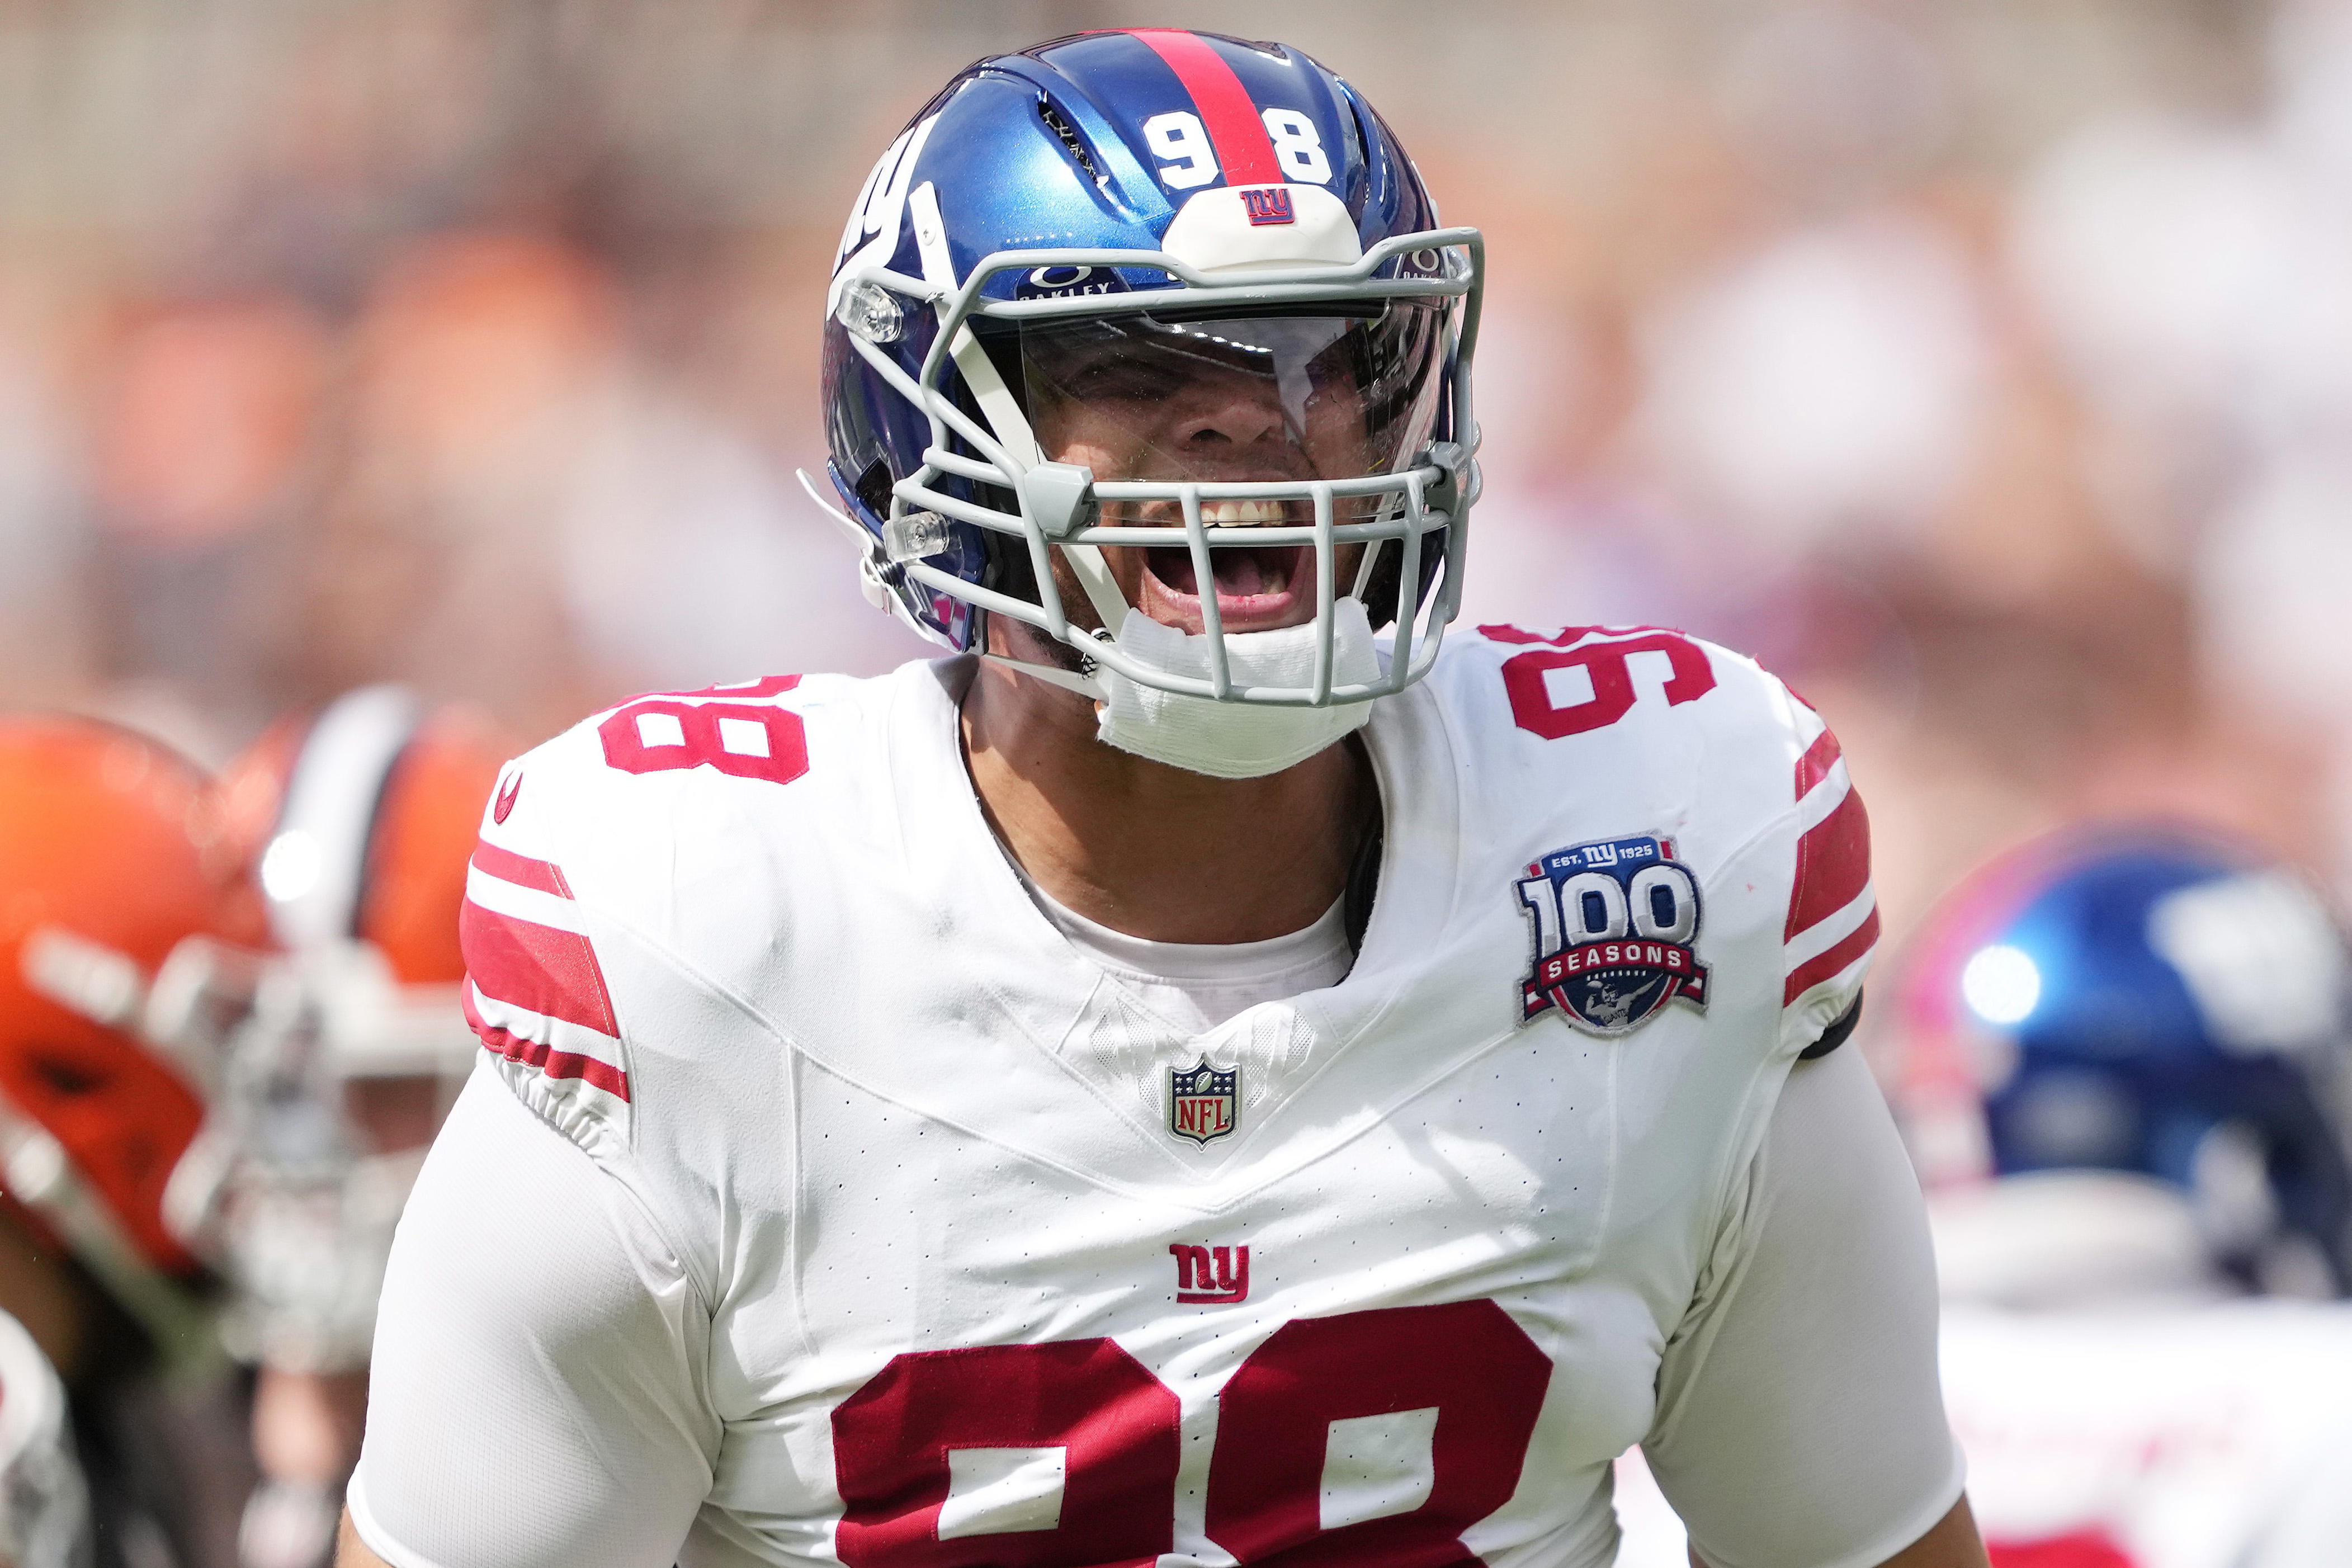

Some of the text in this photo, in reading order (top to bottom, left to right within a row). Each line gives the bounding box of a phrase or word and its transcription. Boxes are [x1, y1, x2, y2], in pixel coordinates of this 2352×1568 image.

[1239, 187, 1295, 226] ny
[1552, 843, 1653, 868] EST. ny 1925
[1523, 865, 1696, 958] 100
[1548, 944, 1682, 979] SEASONS
[1178, 1098, 1230, 1135] NFL
[1169, 1244, 1249, 1303] ny
